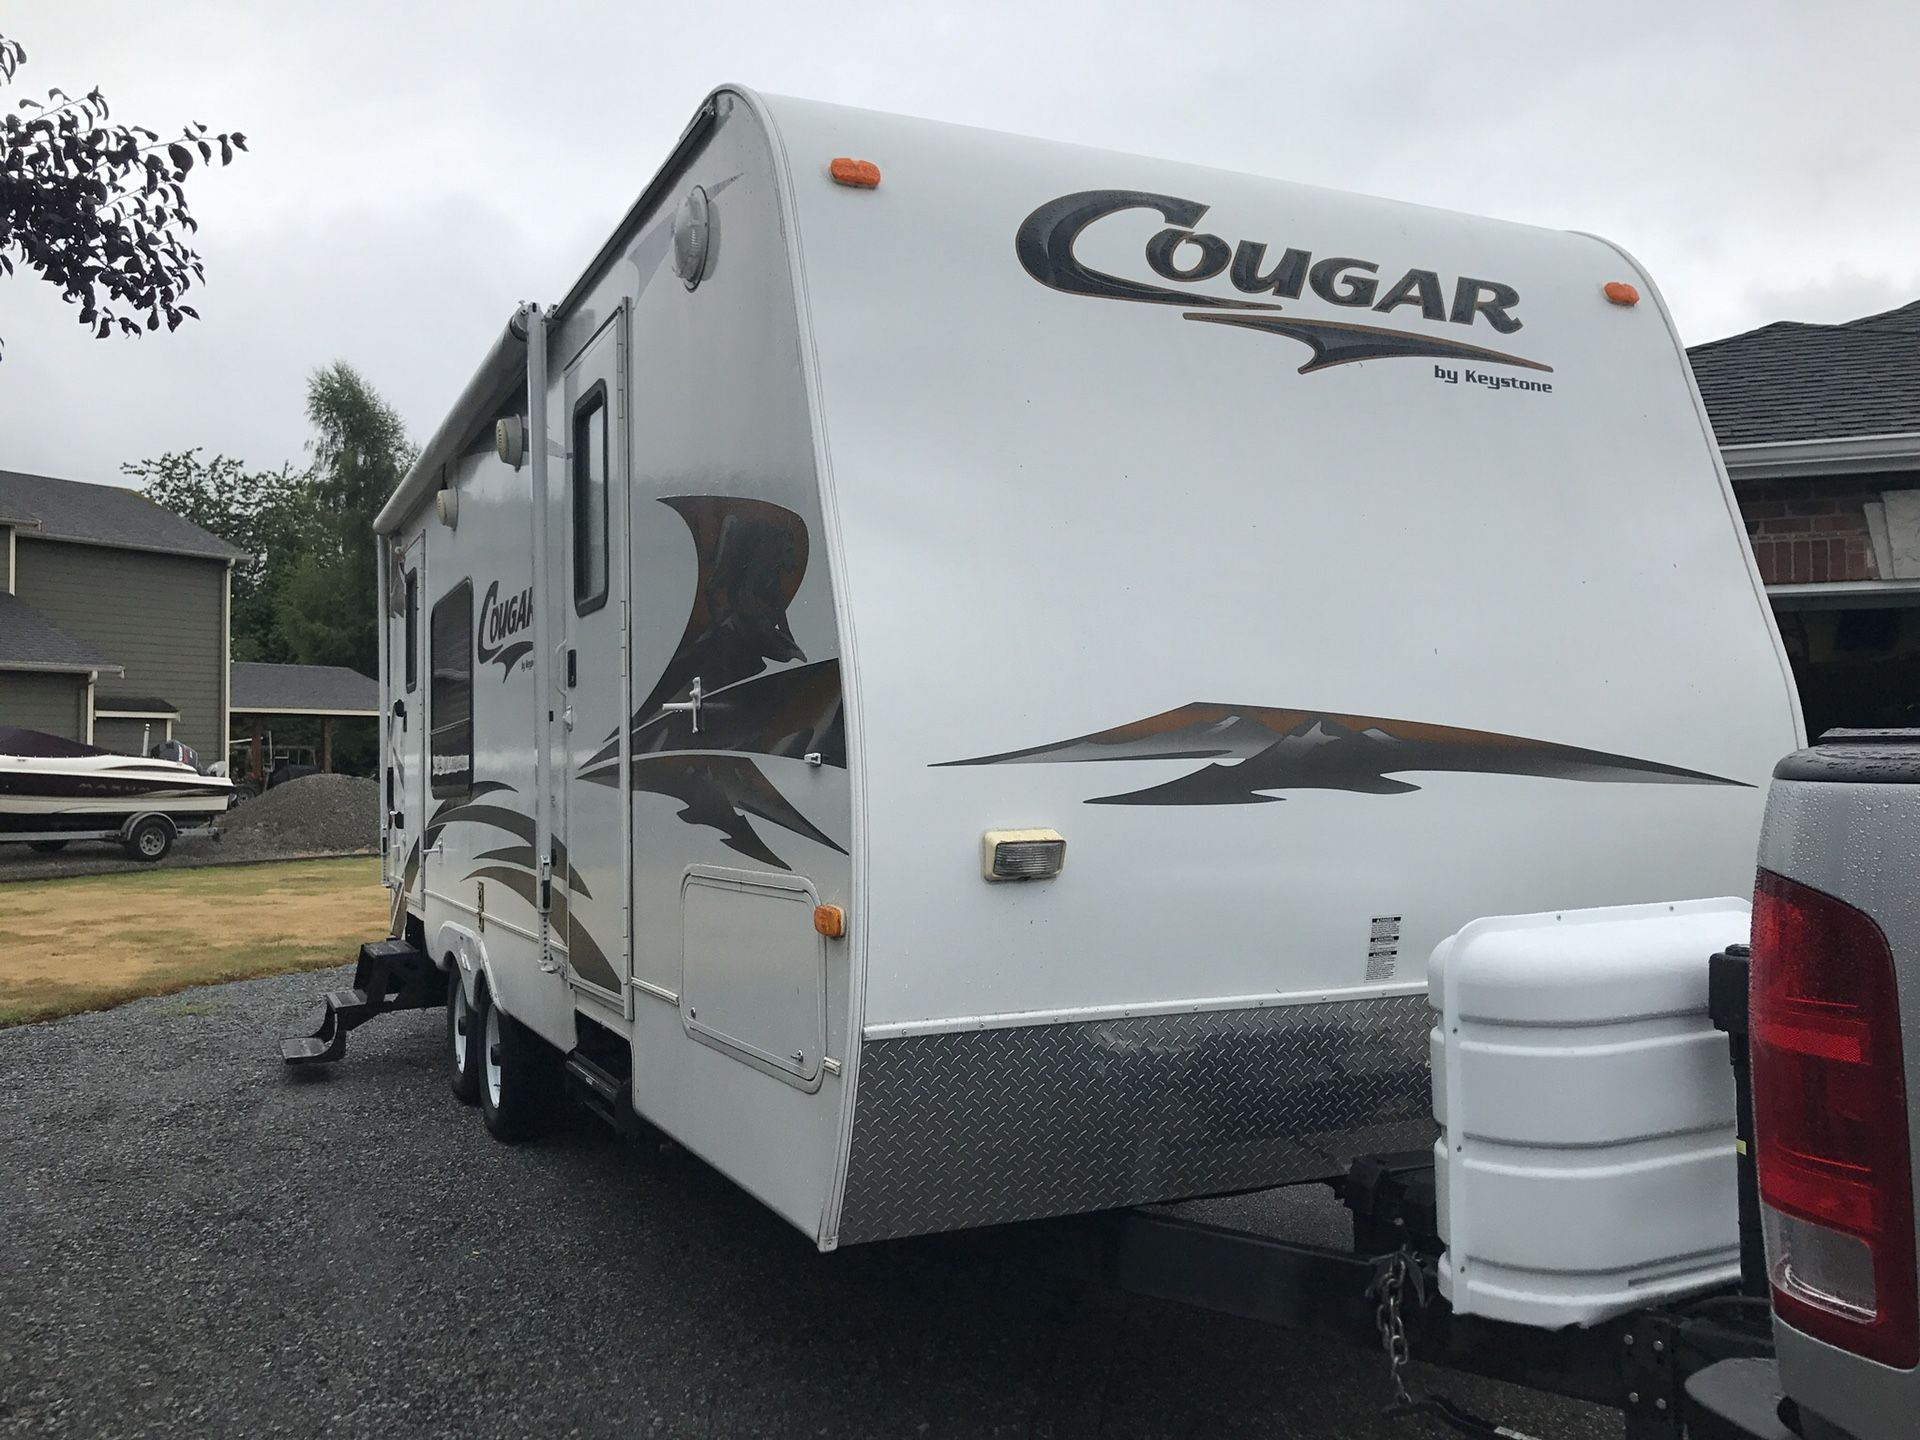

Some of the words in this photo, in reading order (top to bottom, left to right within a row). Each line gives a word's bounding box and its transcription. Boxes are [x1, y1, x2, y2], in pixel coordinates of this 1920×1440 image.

[1015, 189, 1524, 334] COUGAR
[1434, 364, 1458, 384] by
[1465, 369, 1553, 394] Keystone
